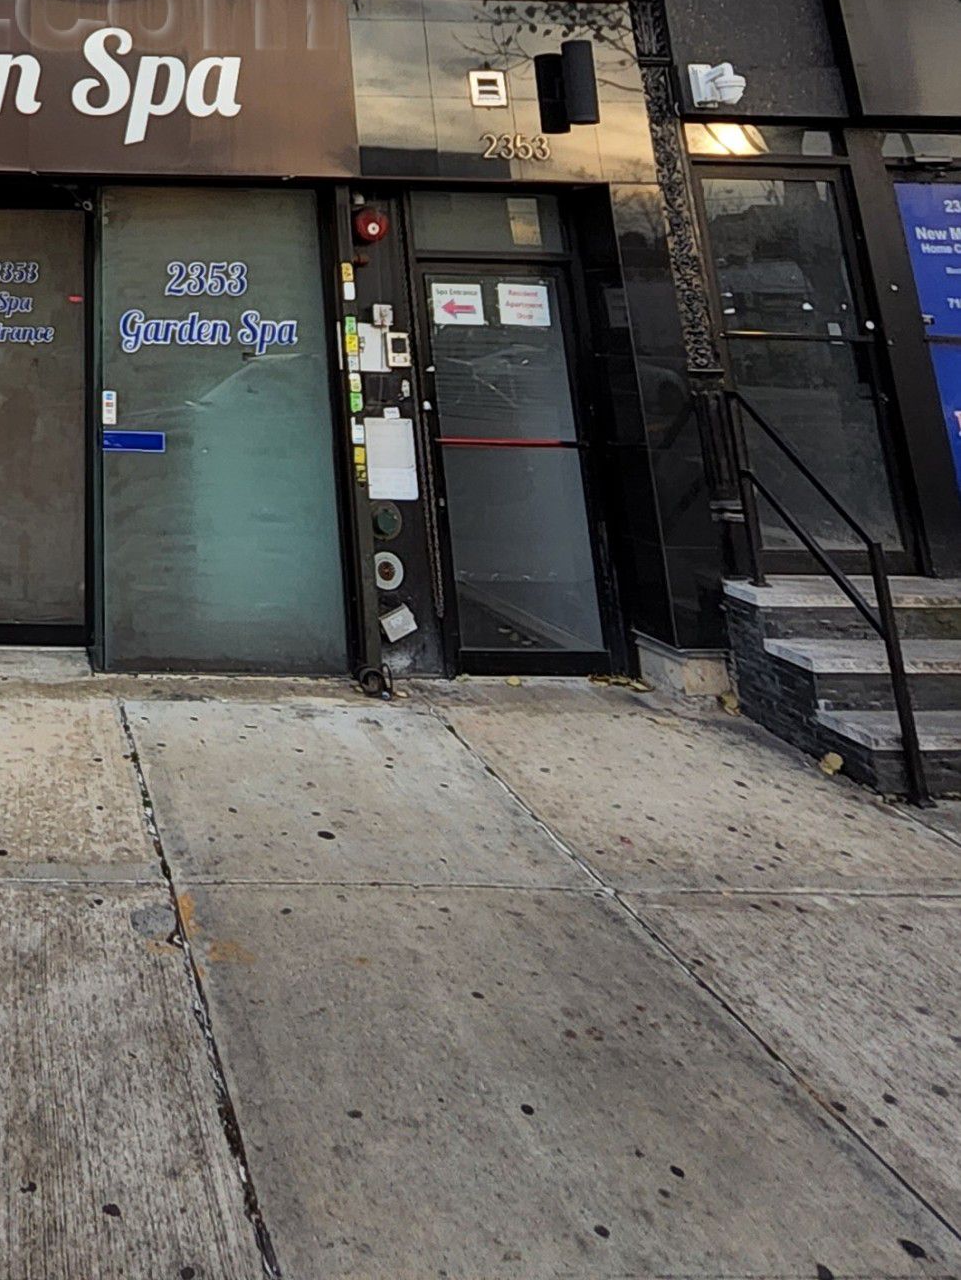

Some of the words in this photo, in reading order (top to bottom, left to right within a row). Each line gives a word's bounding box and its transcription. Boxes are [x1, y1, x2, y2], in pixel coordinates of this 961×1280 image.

[71, 27, 241, 145] Spa
[479, 132, 551, 160] 2353
[915, 226, 947, 240] New
[164, 261, 248, 296] 2353
[119, 309, 231, 353] Garden
[238, 310, 298, 355] Spa
